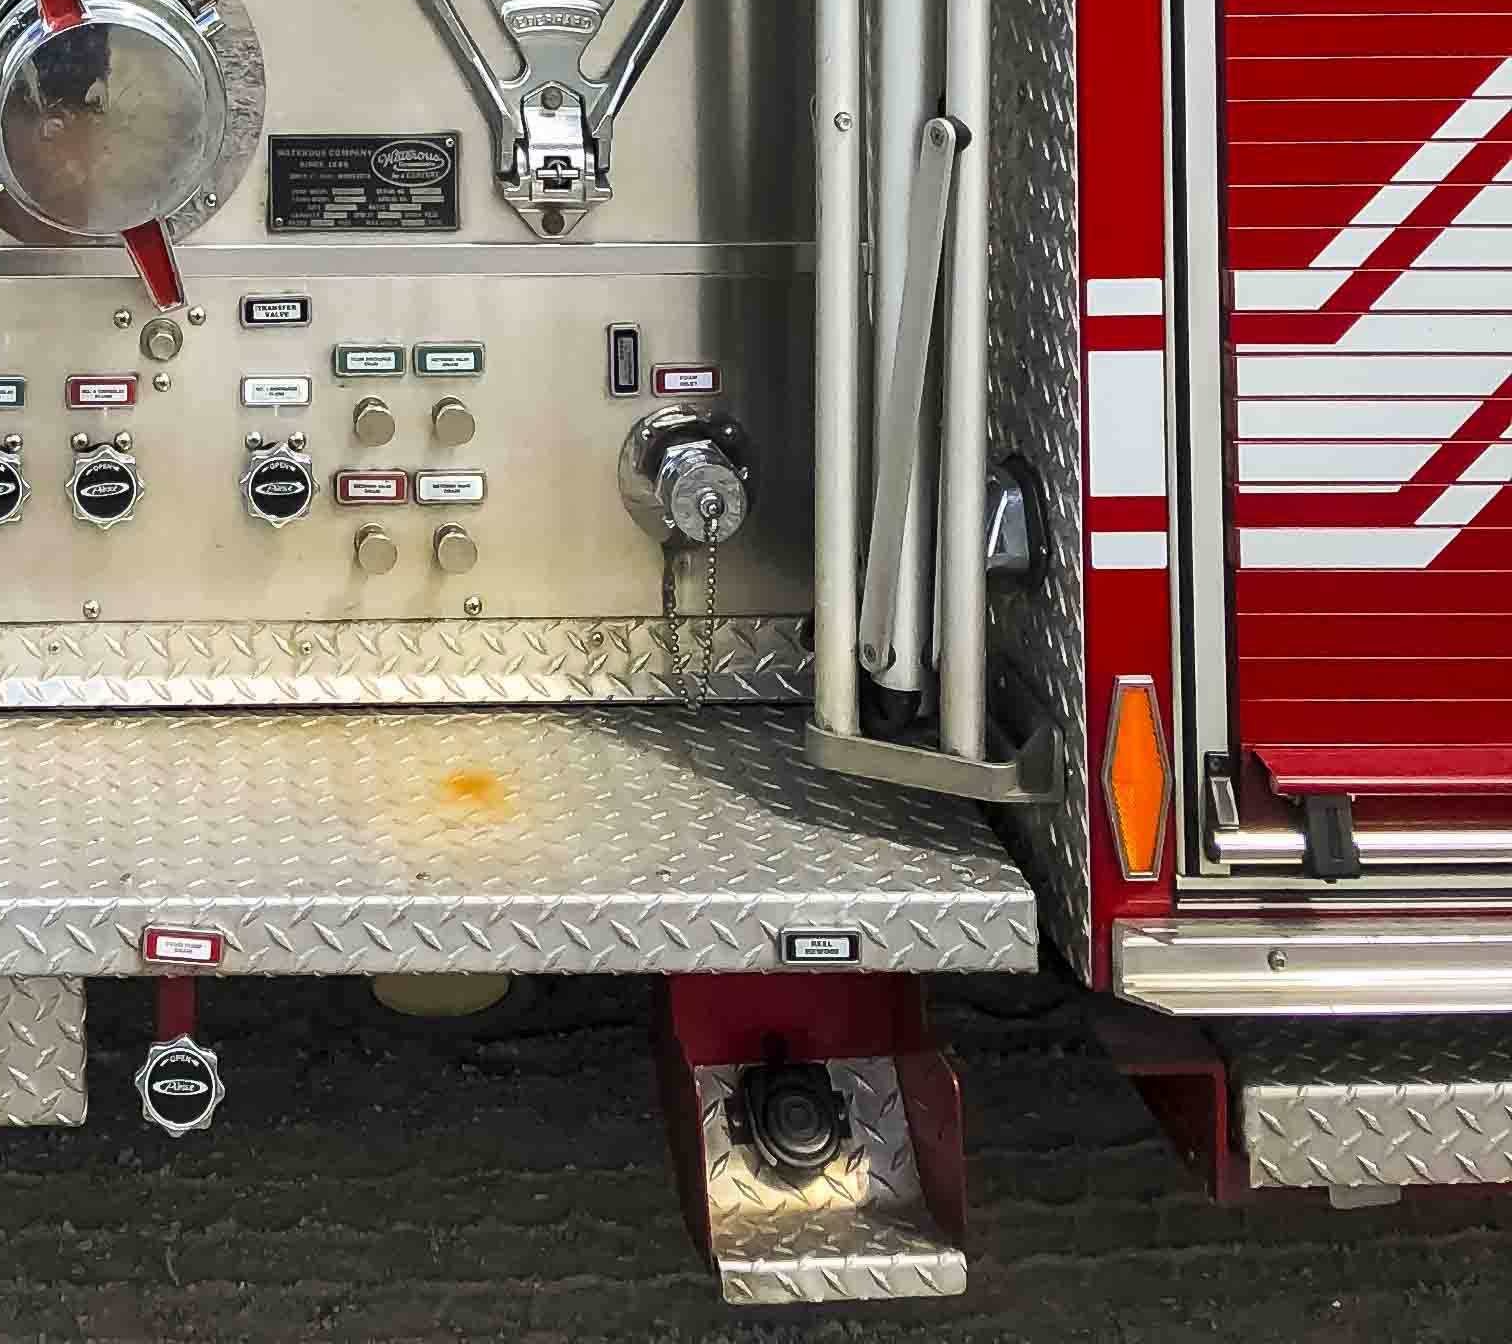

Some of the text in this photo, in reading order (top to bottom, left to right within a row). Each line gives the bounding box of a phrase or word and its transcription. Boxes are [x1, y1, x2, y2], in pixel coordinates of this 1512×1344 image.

[92, 464, 113, 472] OPEN
[269, 462, 290, 470] OPEN
[169, 1054, 192, 1063] OPEN
